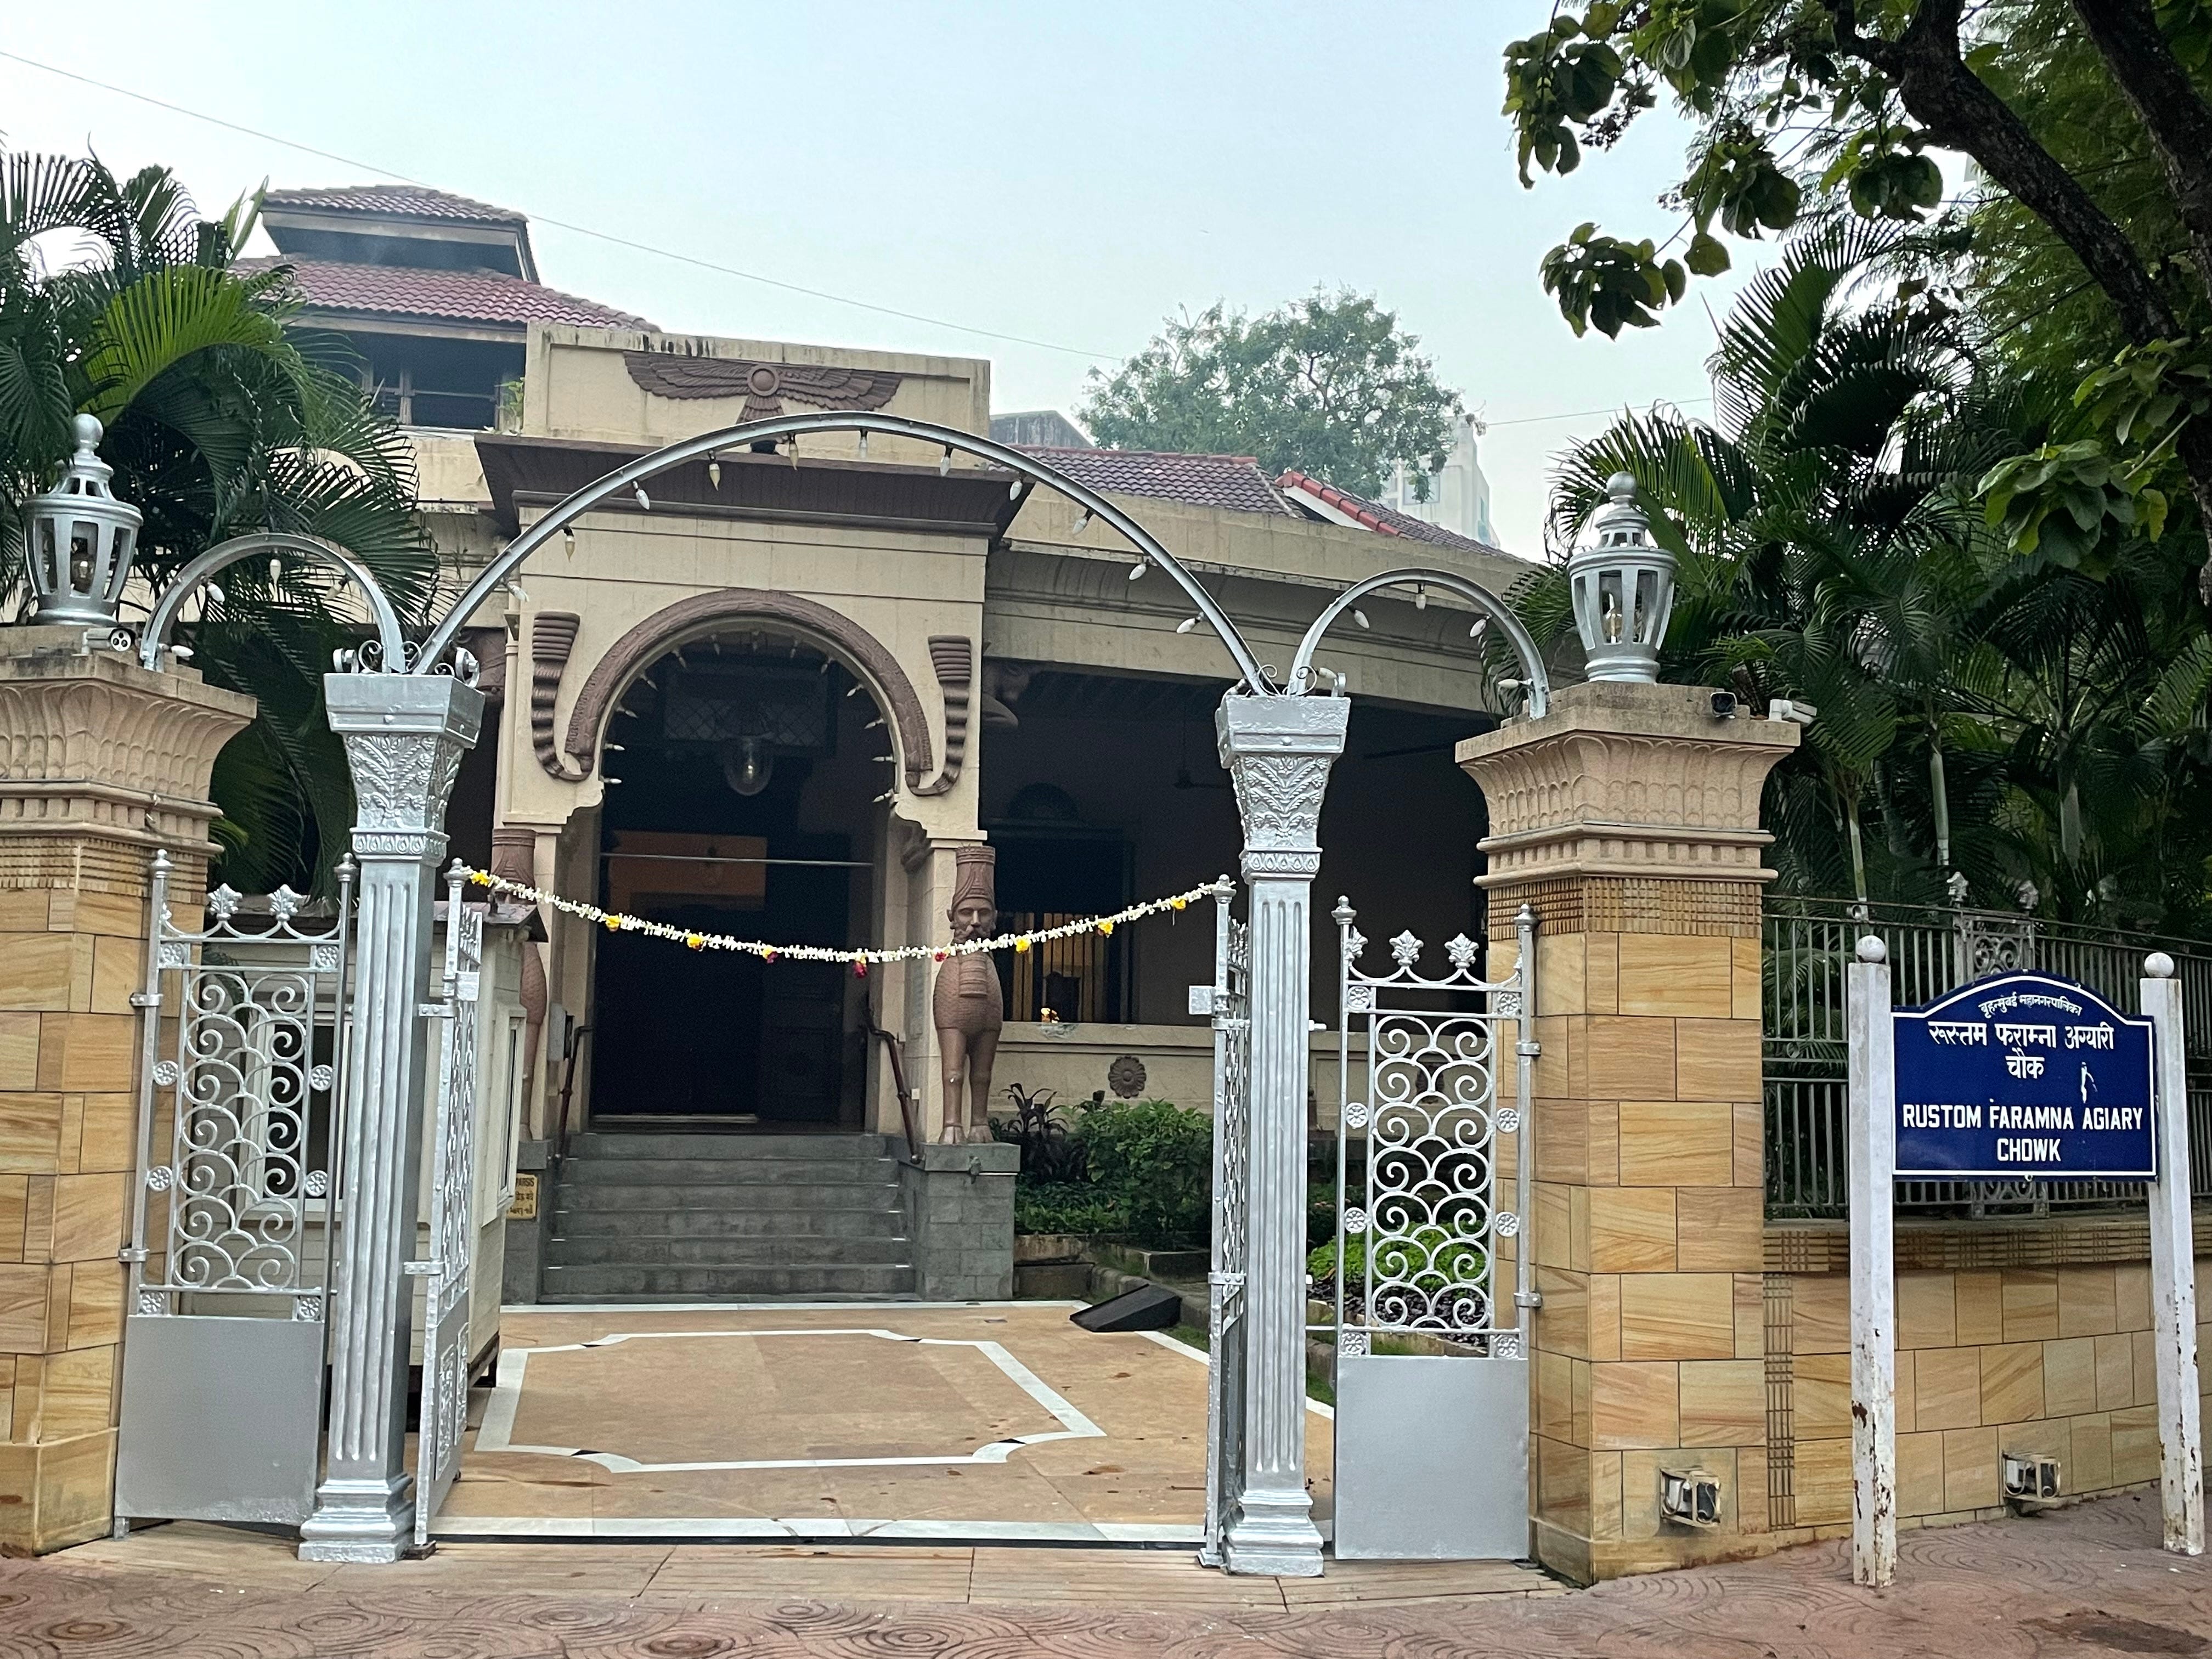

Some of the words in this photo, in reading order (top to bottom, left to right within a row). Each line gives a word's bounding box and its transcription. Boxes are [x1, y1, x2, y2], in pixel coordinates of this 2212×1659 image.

[2018, 995, 2083, 1017] महानगरपालिका
[1927, 1021, 1987, 1046] रूस्तम
[1994, 1023, 2057, 1049] फराम्ना
[2064, 1021, 2114, 1049] अग्यारी
[2005, 1047, 2045, 1079] चौक
[1903, 1104, 1982, 1128] RUSTOM
[1989, 1105, 2074, 1130] FARAMNA
[2082, 1107, 2143, 1130] AGIARY
[1997, 1138, 2061, 1162] CHOWK
